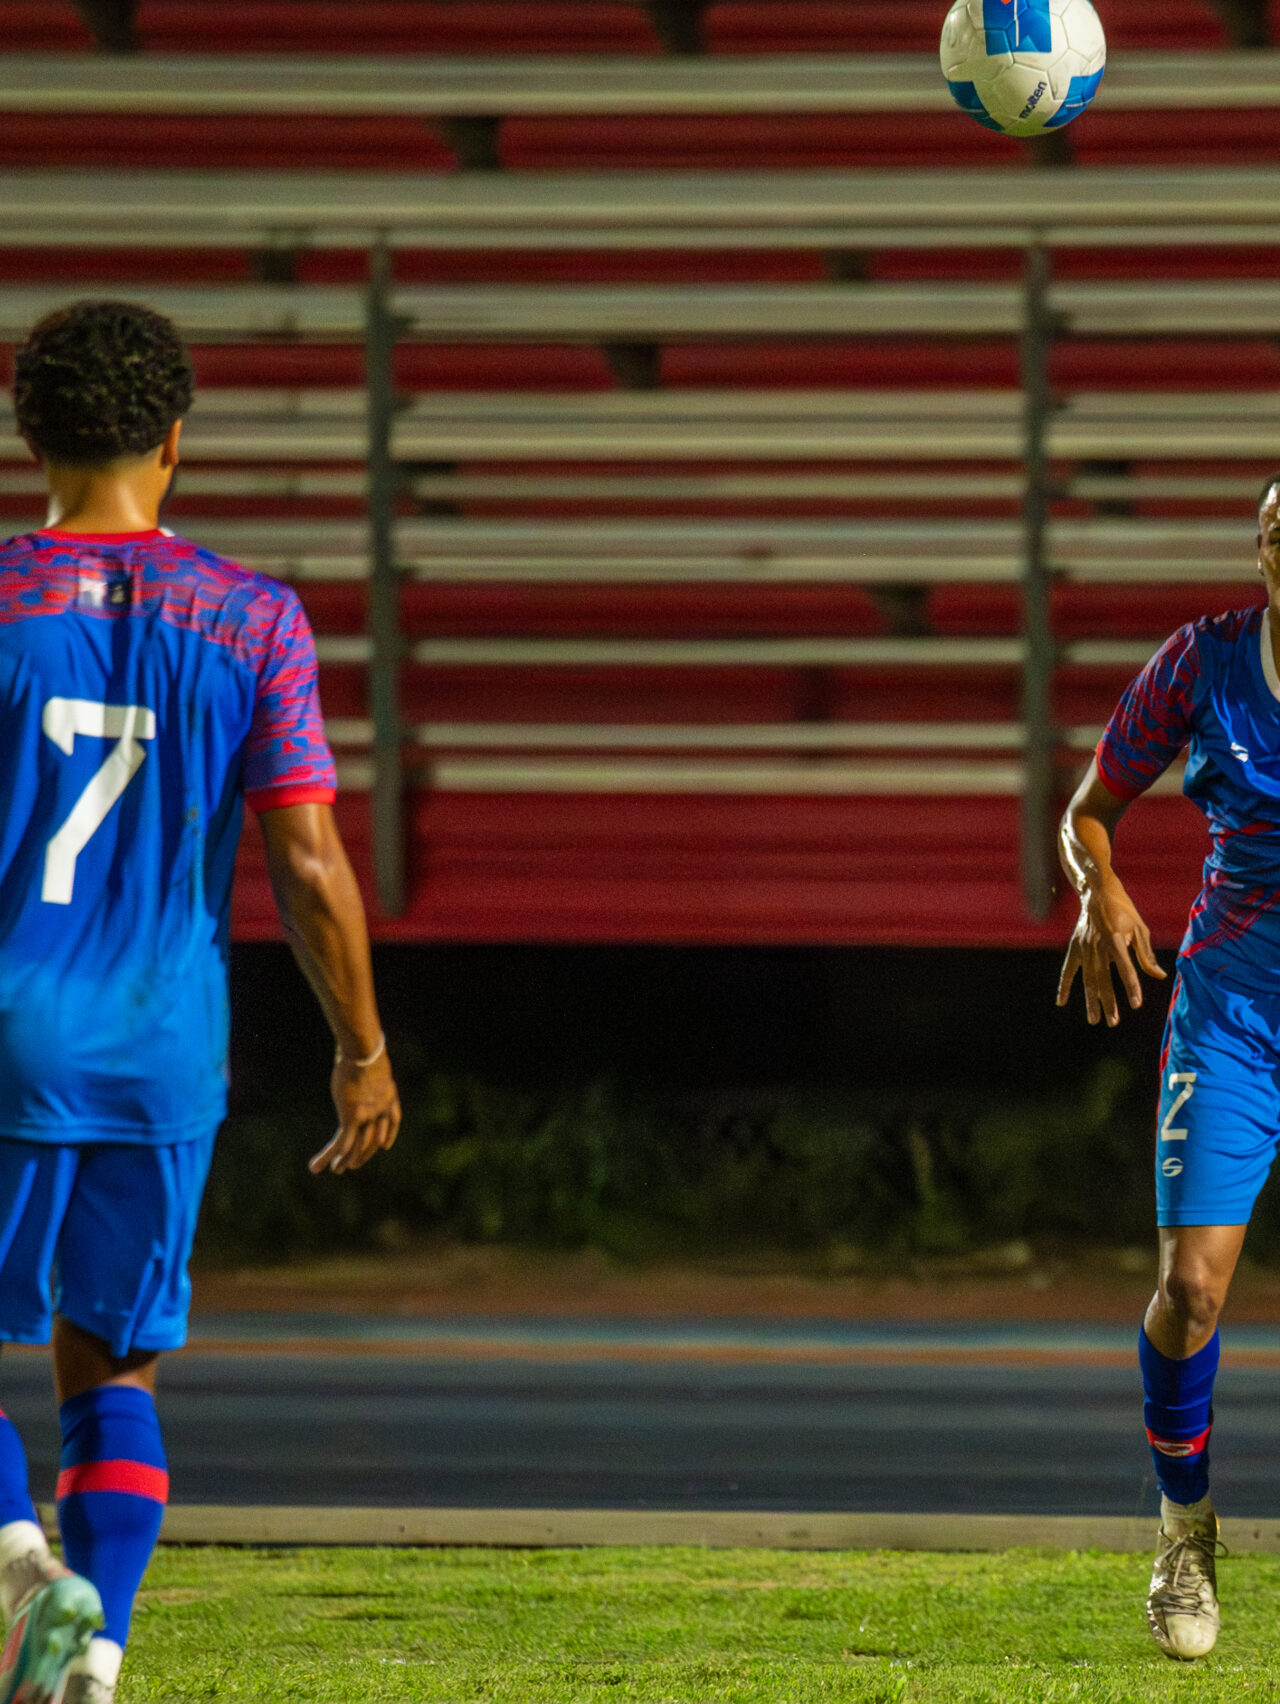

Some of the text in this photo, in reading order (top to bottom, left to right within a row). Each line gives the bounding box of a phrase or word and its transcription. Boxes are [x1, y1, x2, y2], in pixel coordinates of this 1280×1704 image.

[1019, 81, 1047, 119] molten
[42, 697, 156, 905] 7
[1161, 1072, 1197, 1141] 2
